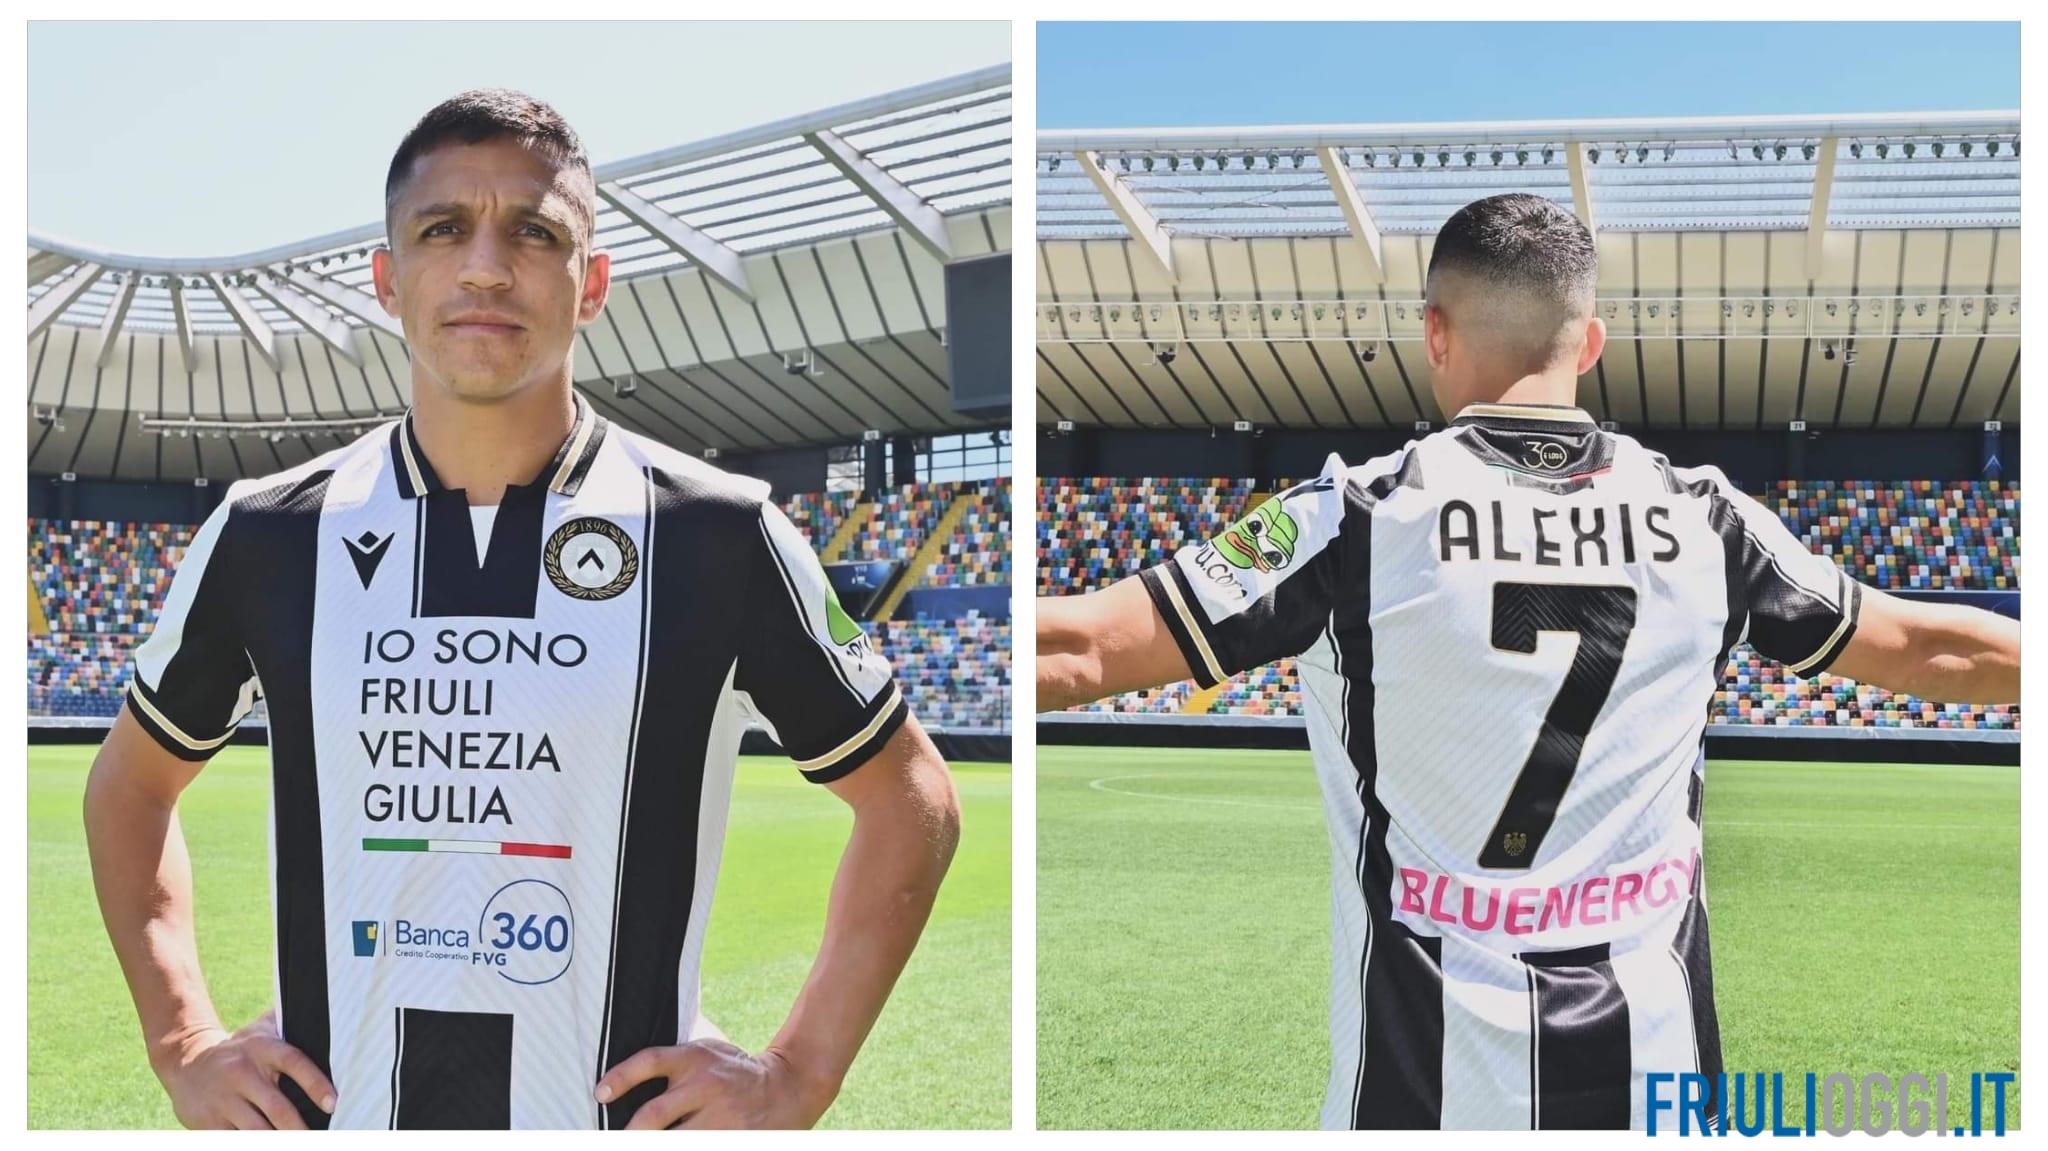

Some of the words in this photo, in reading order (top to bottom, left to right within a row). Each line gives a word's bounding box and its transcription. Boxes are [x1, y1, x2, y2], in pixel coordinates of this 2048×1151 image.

[1523, 441, 1567, 469] 30
[580, 520, 609, 533] 1896
[1439, 499, 1680, 566] ALEXIS
[364, 629, 415, 664] IO
[433, 628, 588, 667] SONO
[360, 678, 493, 716] FRIULI
[1477, 580, 1638, 870] 7
[358, 729, 561, 773] VENEZIA
[363, 783, 513, 825] GIULIA
[1399, 846, 1698, 936] BLUENERGY
[395, 920, 470, 948] Banca
[490, 911, 569, 953] 360
[395, 949, 423, 958] Credito
[424, 950, 469, 961] Cooperativo
[472, 952, 507, 966] FVG
